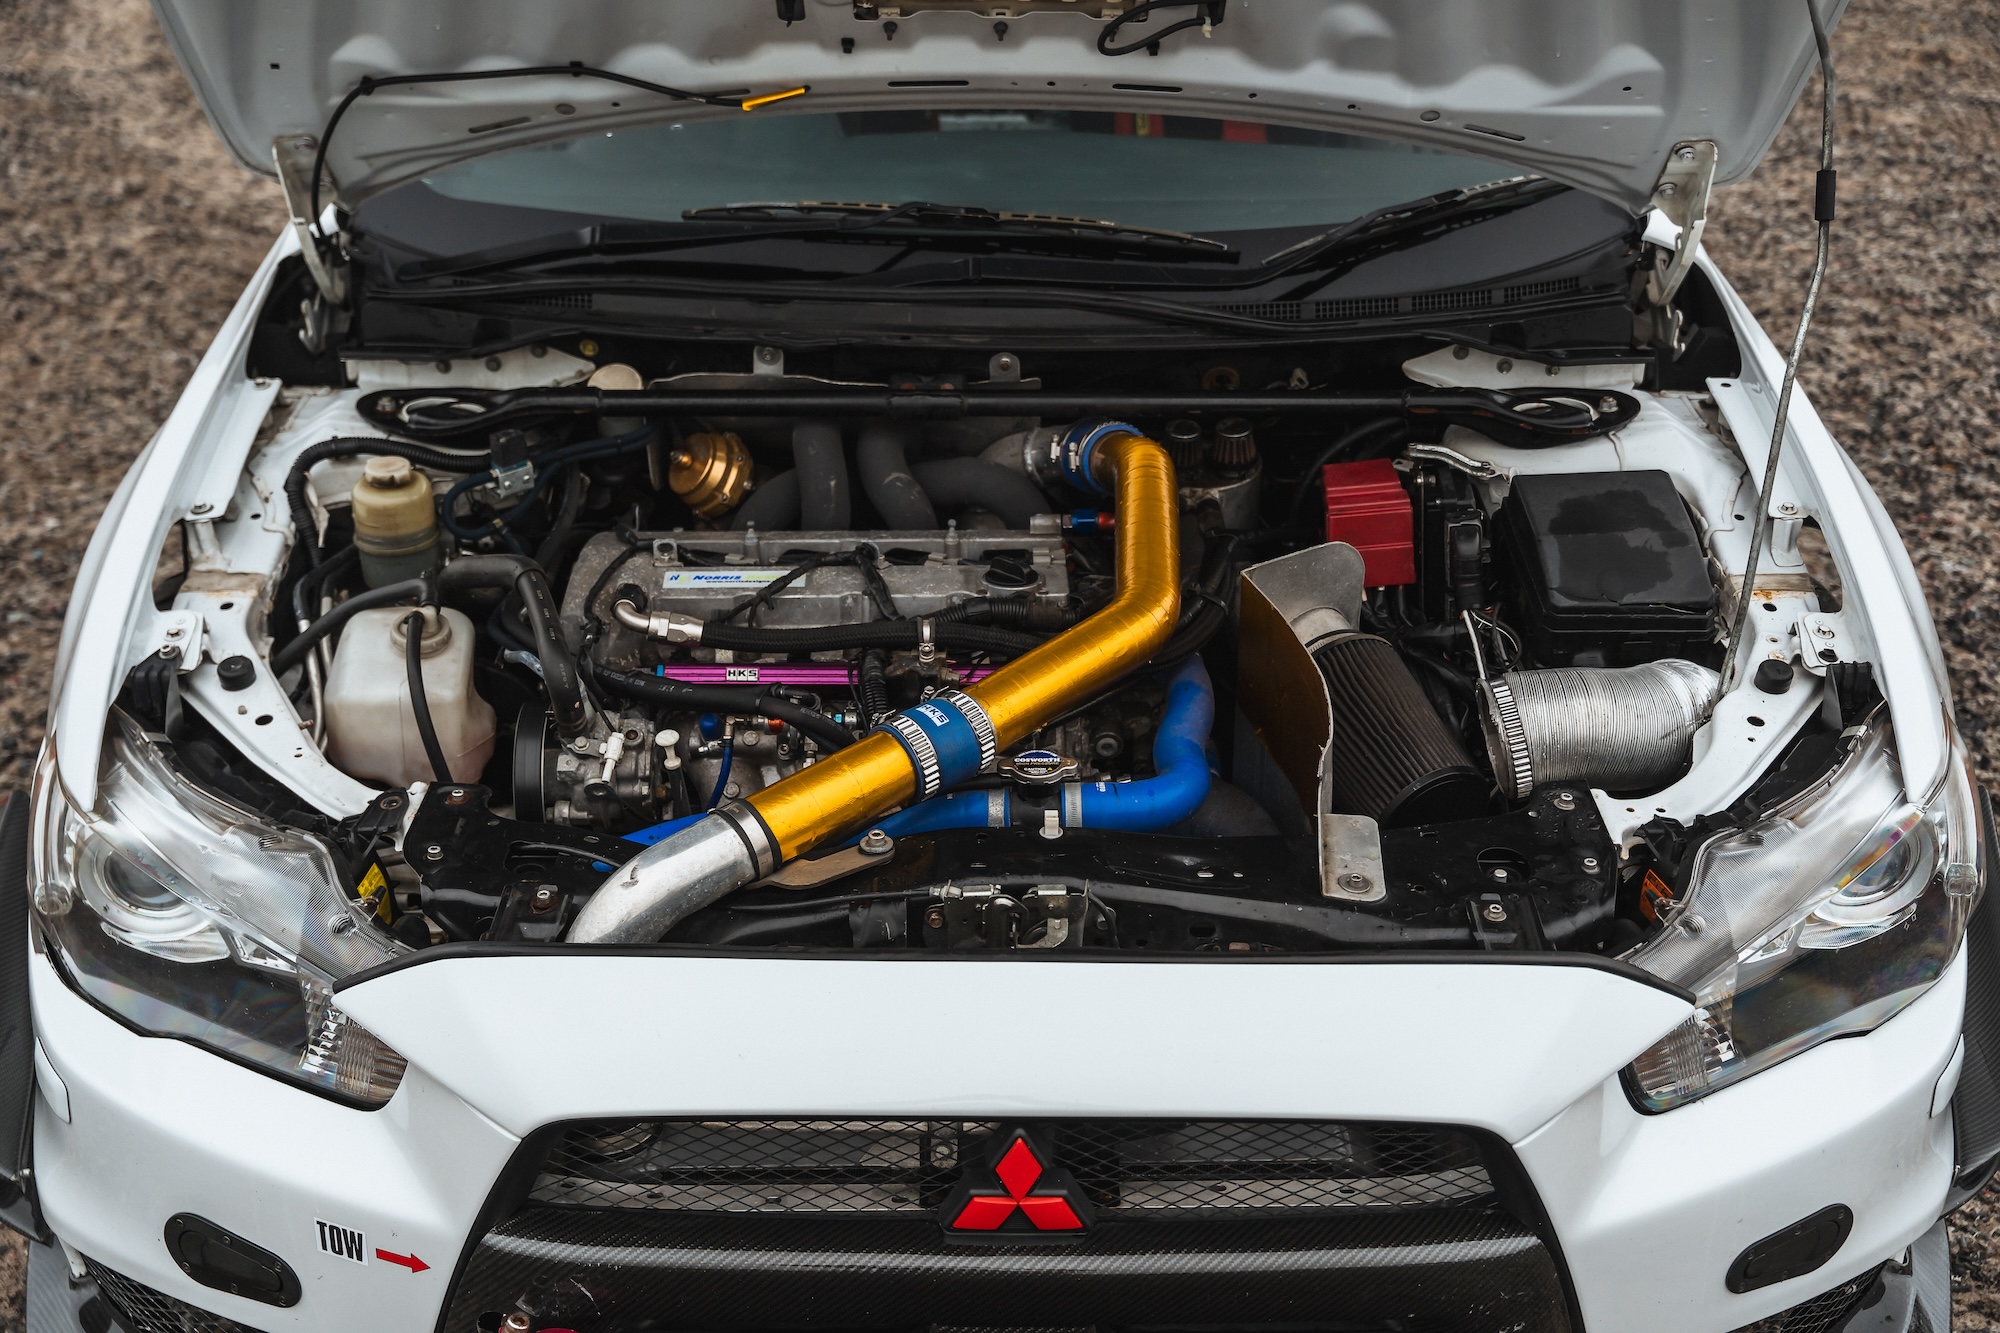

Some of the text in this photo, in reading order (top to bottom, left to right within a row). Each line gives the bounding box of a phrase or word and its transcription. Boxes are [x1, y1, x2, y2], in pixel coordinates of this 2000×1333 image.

[727, 669, 758, 679] HKS
[919, 704, 949, 724] HKS
[316, 1220, 363, 1262] TOW
